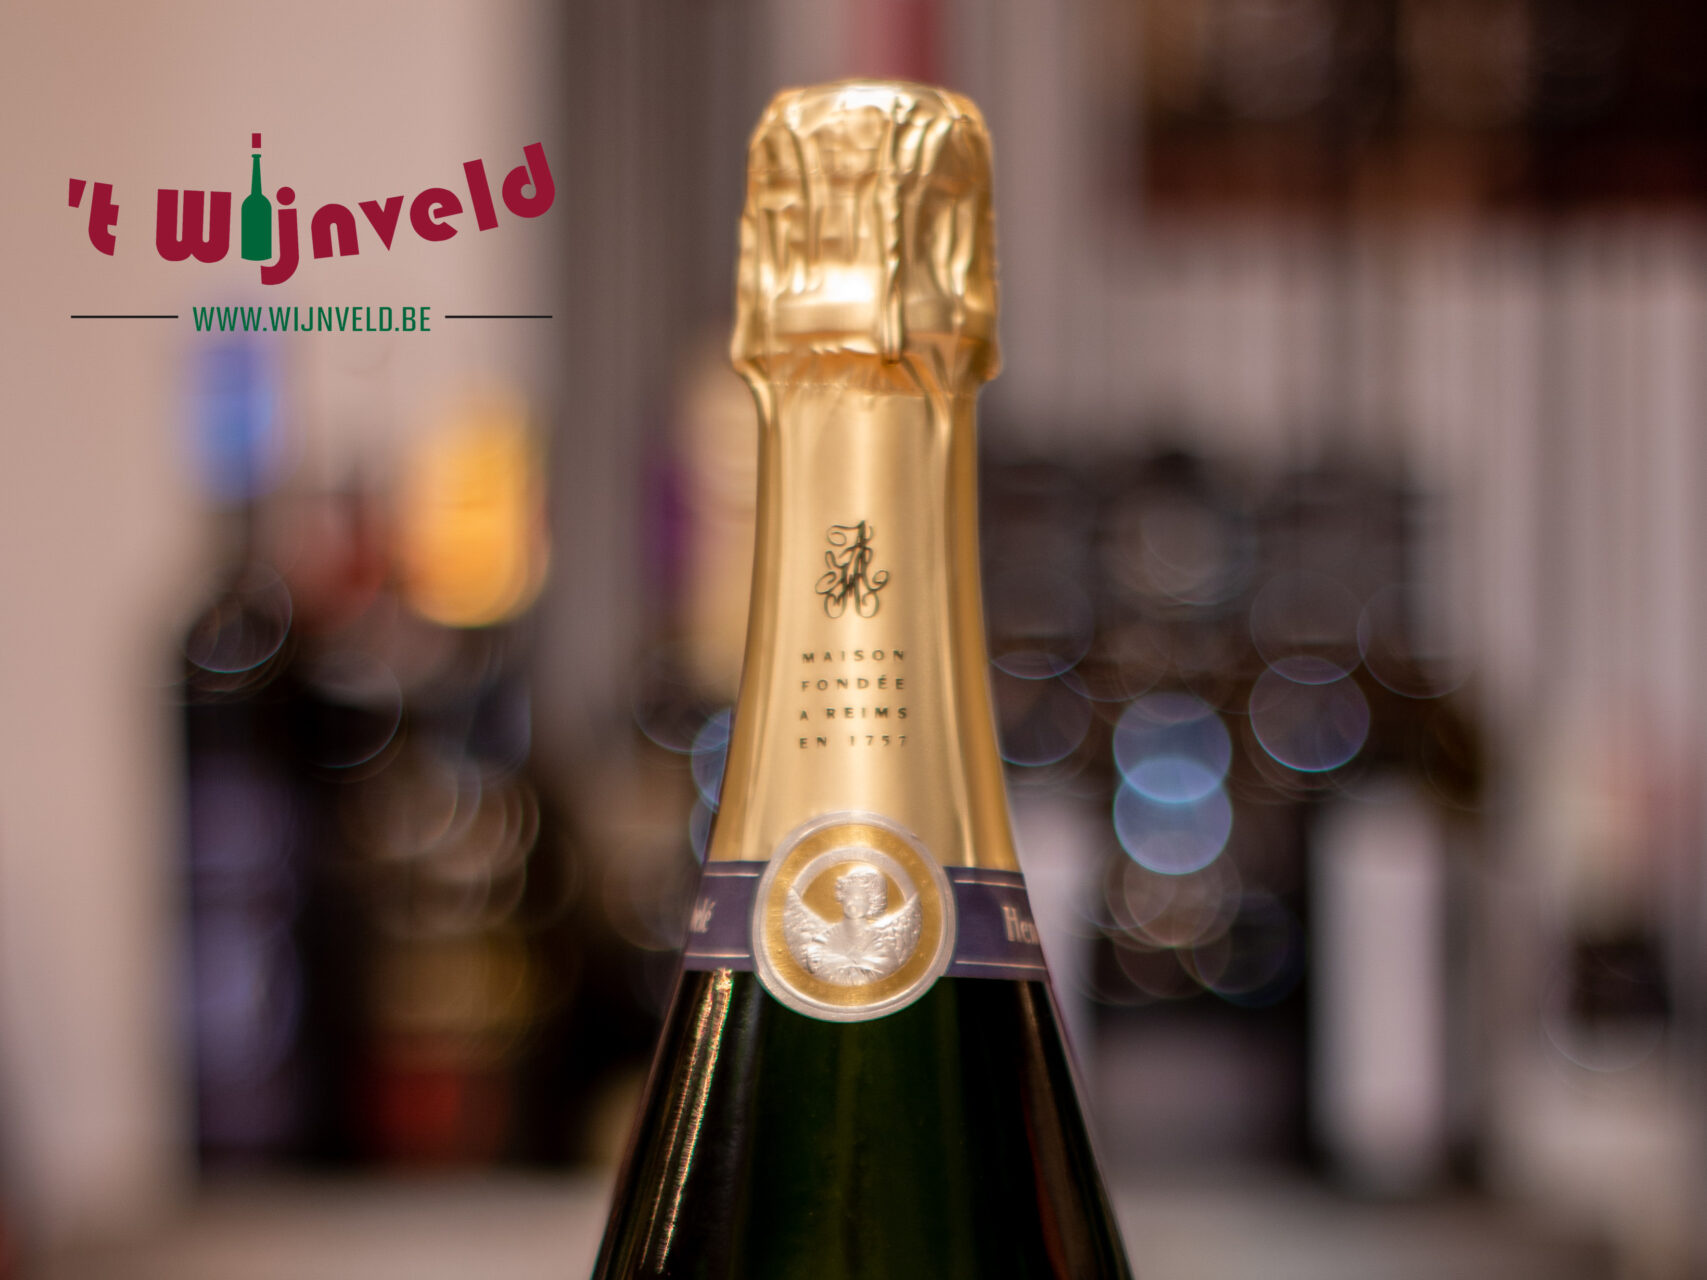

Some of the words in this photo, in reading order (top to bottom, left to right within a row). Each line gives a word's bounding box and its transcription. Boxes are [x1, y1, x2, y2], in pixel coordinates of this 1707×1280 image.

[801, 650, 906, 663] MAISON
[801, 675, 906, 691] FONDÉE
[826, 706, 909, 721] REIMS
[799, 736, 829, 749] EN
[848, 734, 909, 748] 1757
